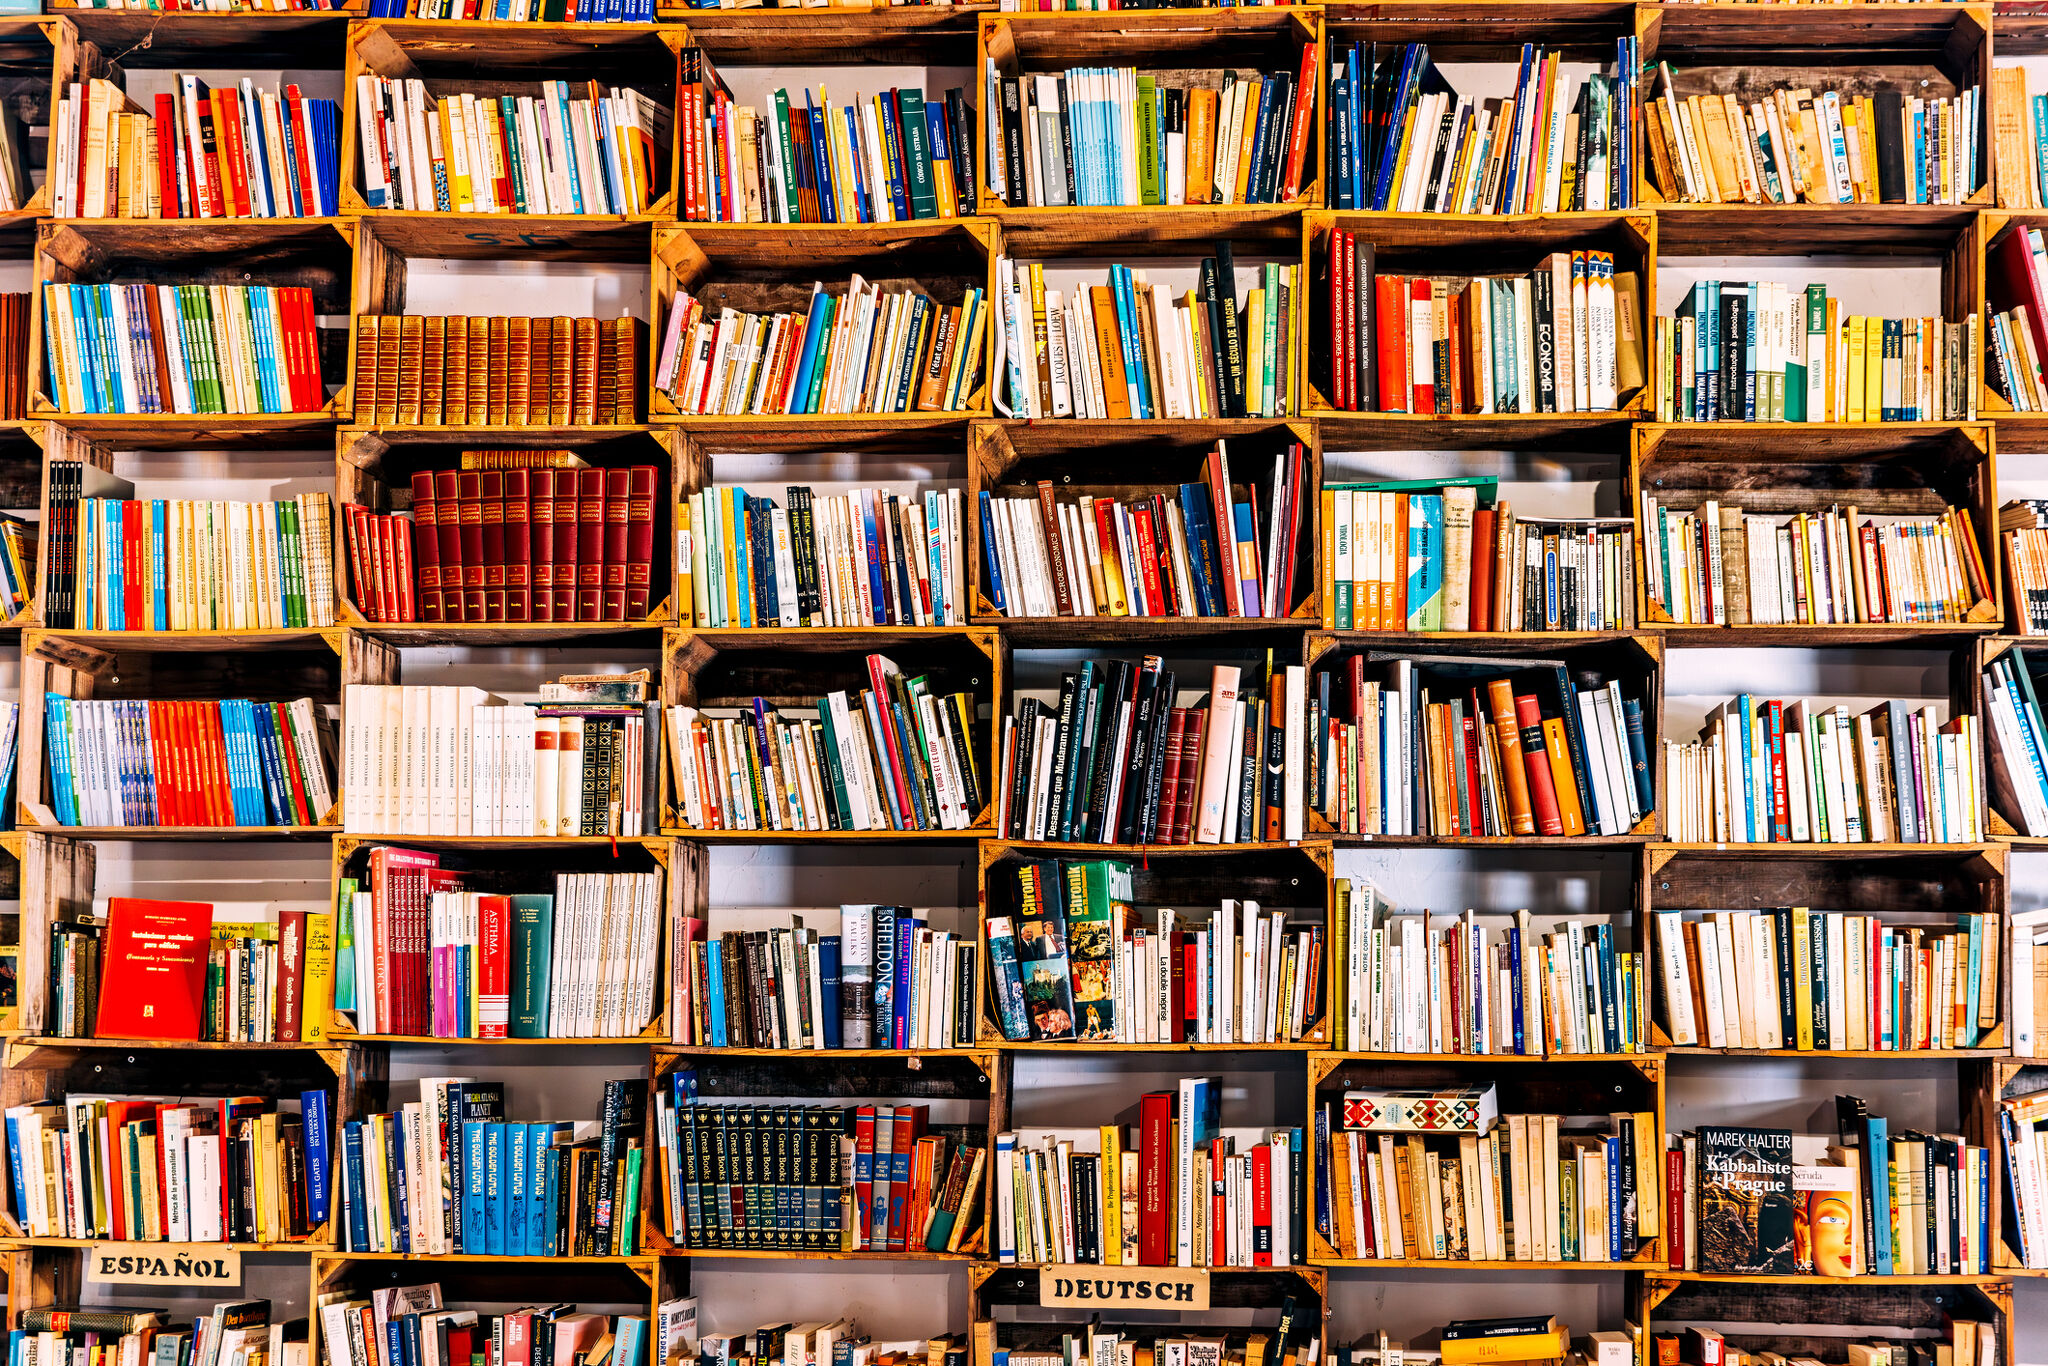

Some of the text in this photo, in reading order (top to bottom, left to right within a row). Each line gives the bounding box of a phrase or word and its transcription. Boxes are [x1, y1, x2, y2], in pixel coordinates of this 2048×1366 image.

[882, 102, 890, 129] TRATADOS
[1339, 111, 1347, 146] PUBLICIDADE
[912, 127, 926, 183] CÓDIGO DA ESTRADA
[1341, 147, 1346, 155] DA
[1224, 297, 1236, 327] IMAGENS
[1730, 299, 1739, 339] psicologia
[946, 322, 956, 344] 2001
[1228, 329, 1237, 338] DE
[1698, 311, 1706, 349] IMUNOLOGIA
[1710, 309, 1718, 346] IMUNOLOGIA
[1746, 310, 1755, 347] IMUNOLOGIA
[929, 314, 949, 374] l'état du monde
[1049, 307, 1067, 385] JACQUES LOEW
[1103, 328, 1111, 357] COMERCIAL
[1227, 340, 1239, 364] SÉCULO
[1438, 310, 1447, 389] MACROECONOMIA
[1231, 365, 1241, 376] UM
[1539, 323, 1552, 393] ECONOMIA
[1729, 349, 1738, 391] introdução
[1695, 377, 1706, 400] VOLUME
[1707, 374, 1718, 399] VOLUME
[1745, 373, 1755, 399] VOLUME
[1420, 520, 1429, 547] BANCÁRIO
[1140, 515, 1156, 590] Galiza em tinta vermelha
[1200, 539, 1210, 559] social
[1050, 532, 1068, 604] MACROECONOMICS
[1420, 556, 1428, 589] PRONTUÁRIO
[1356, 585, 1364, 607] VOLUME
[1370, 585, 1378, 605] VOLUME
[1384, 586, 1392, 607] VOLUME
[956, 614, 963, 622] 16
[1060, 693, 1072, 725] Mundo
[929, 740, 945, 792] L'OURS ET LE LOUP
[1016, 750, 1025, 780] mystérieuse
[1054, 732, 1069, 775] Mudaram
[1244, 757, 1255, 779] MAY
[1053, 775, 1064, 793] que
[1091, 788, 1100, 812] ROMA
[1241, 795, 1252, 817] 1999
[1047, 794, 1061, 837] Desastres
[1018, 864, 1037, 916] Chronik
[1031, 864, 1044, 915] der Deutschen
[1067, 866, 1083, 916] Chronik
[1108, 862, 1134, 902] Chronik
[131, 931, 194, 941] Instalaciones sanitarias
[143, 942, 181, 950] para edificios
[489, 909, 499, 955] ASTHMA
[860, 912, 868, 963] SEBASTIAN
[877, 915, 894, 984] SHELDON
[901, 924, 910, 985] FLORIDA STRAITS
[285, 976, 295, 1023] Goodbye Janette
[1159, 956, 1168, 1021] La double méprise
[855, 985, 863, 1034] Human Traces
[876, 1006, 885, 1034] FALLING
[1605, 1003, 1616, 1031] ISRAËL
[961, 1012, 969, 1038] Commentary
[413, 1112, 422, 1176] MACROECONOMICS
[472, 1131, 482, 1145] THE
[513, 1131, 524, 1145] THE
[535, 1131, 547, 1145] THE
[1706, 1131, 1792, 1150] MAREK HALTER
[472, 1146, 482, 1171] GOLDEN
[513, 1146, 524, 1171] GOLDEN
[535, 1146, 547, 1171] GOLDEN
[686, 1131, 695, 1180] Great Books
[809, 1133, 818, 1181] Great Books
[829, 1133, 838, 1182] Great Books
[1706, 1154, 1796, 1174] Kabbaliste
[313, 1158, 322, 1199] BILL GATES
[472, 1173, 482, 1194] LOTUS
[513, 1173, 524, 1194] LOTUS
[535, 1173, 547, 1194] LOTUS
[1706, 1174, 1786, 1197] de Prague
[100, 1252, 230, 1279] ESPAÑOL
[1055, 1278, 1195, 1302] DEUTSCH
[1278, 1315, 1292, 1335] Brot
